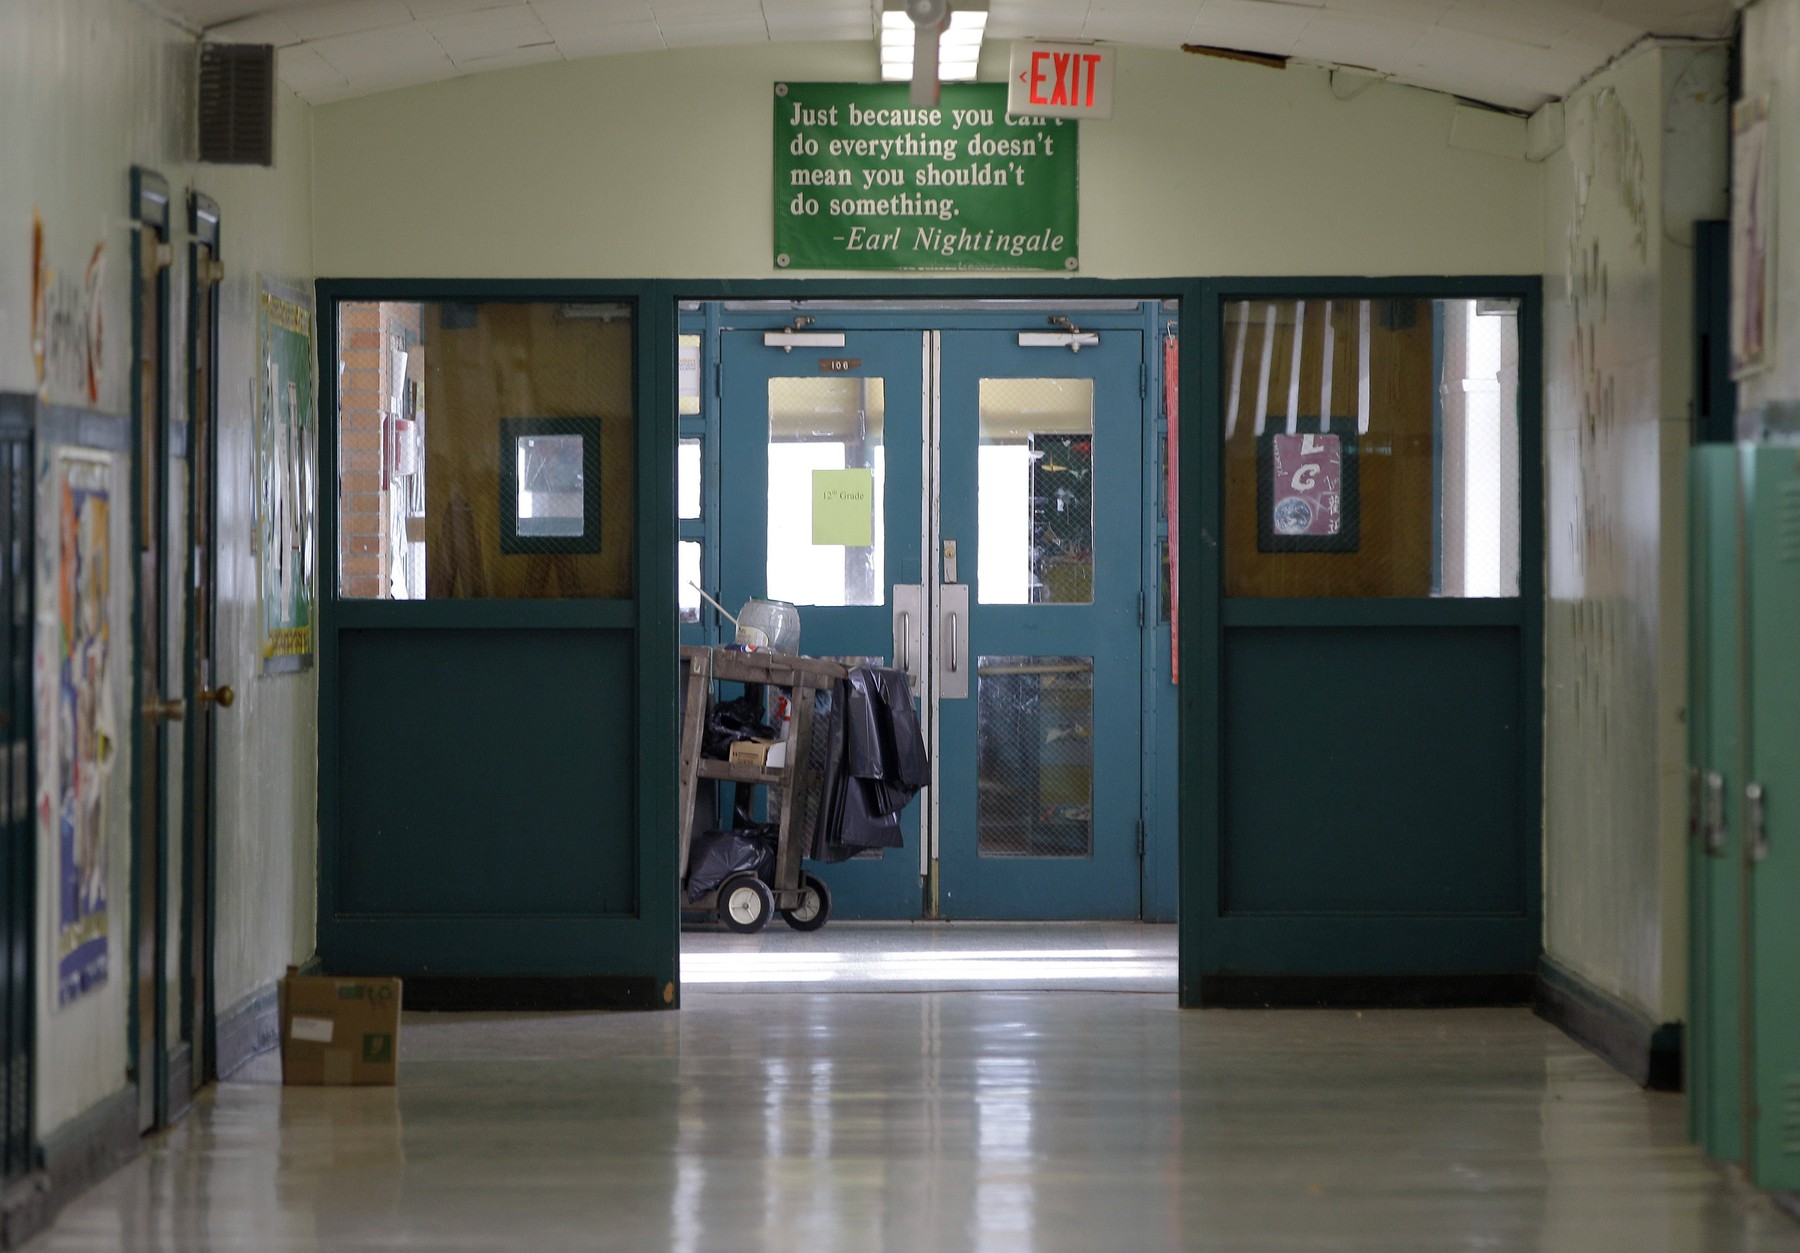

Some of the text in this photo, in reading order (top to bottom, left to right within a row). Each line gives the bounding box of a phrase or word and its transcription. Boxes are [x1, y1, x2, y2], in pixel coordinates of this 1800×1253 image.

[1029, 51, 1102, 108] EXIT
[790, 102, 1064, 130] Just because you can
[790, 132, 1054, 161] do everything doesn't
[790, 162, 1025, 190] mean you shouldn't
[790, 192, 960, 221] do something.
[912, 227, 1065, 256] Nightingale
[839, 491, 865, 500] Grade
